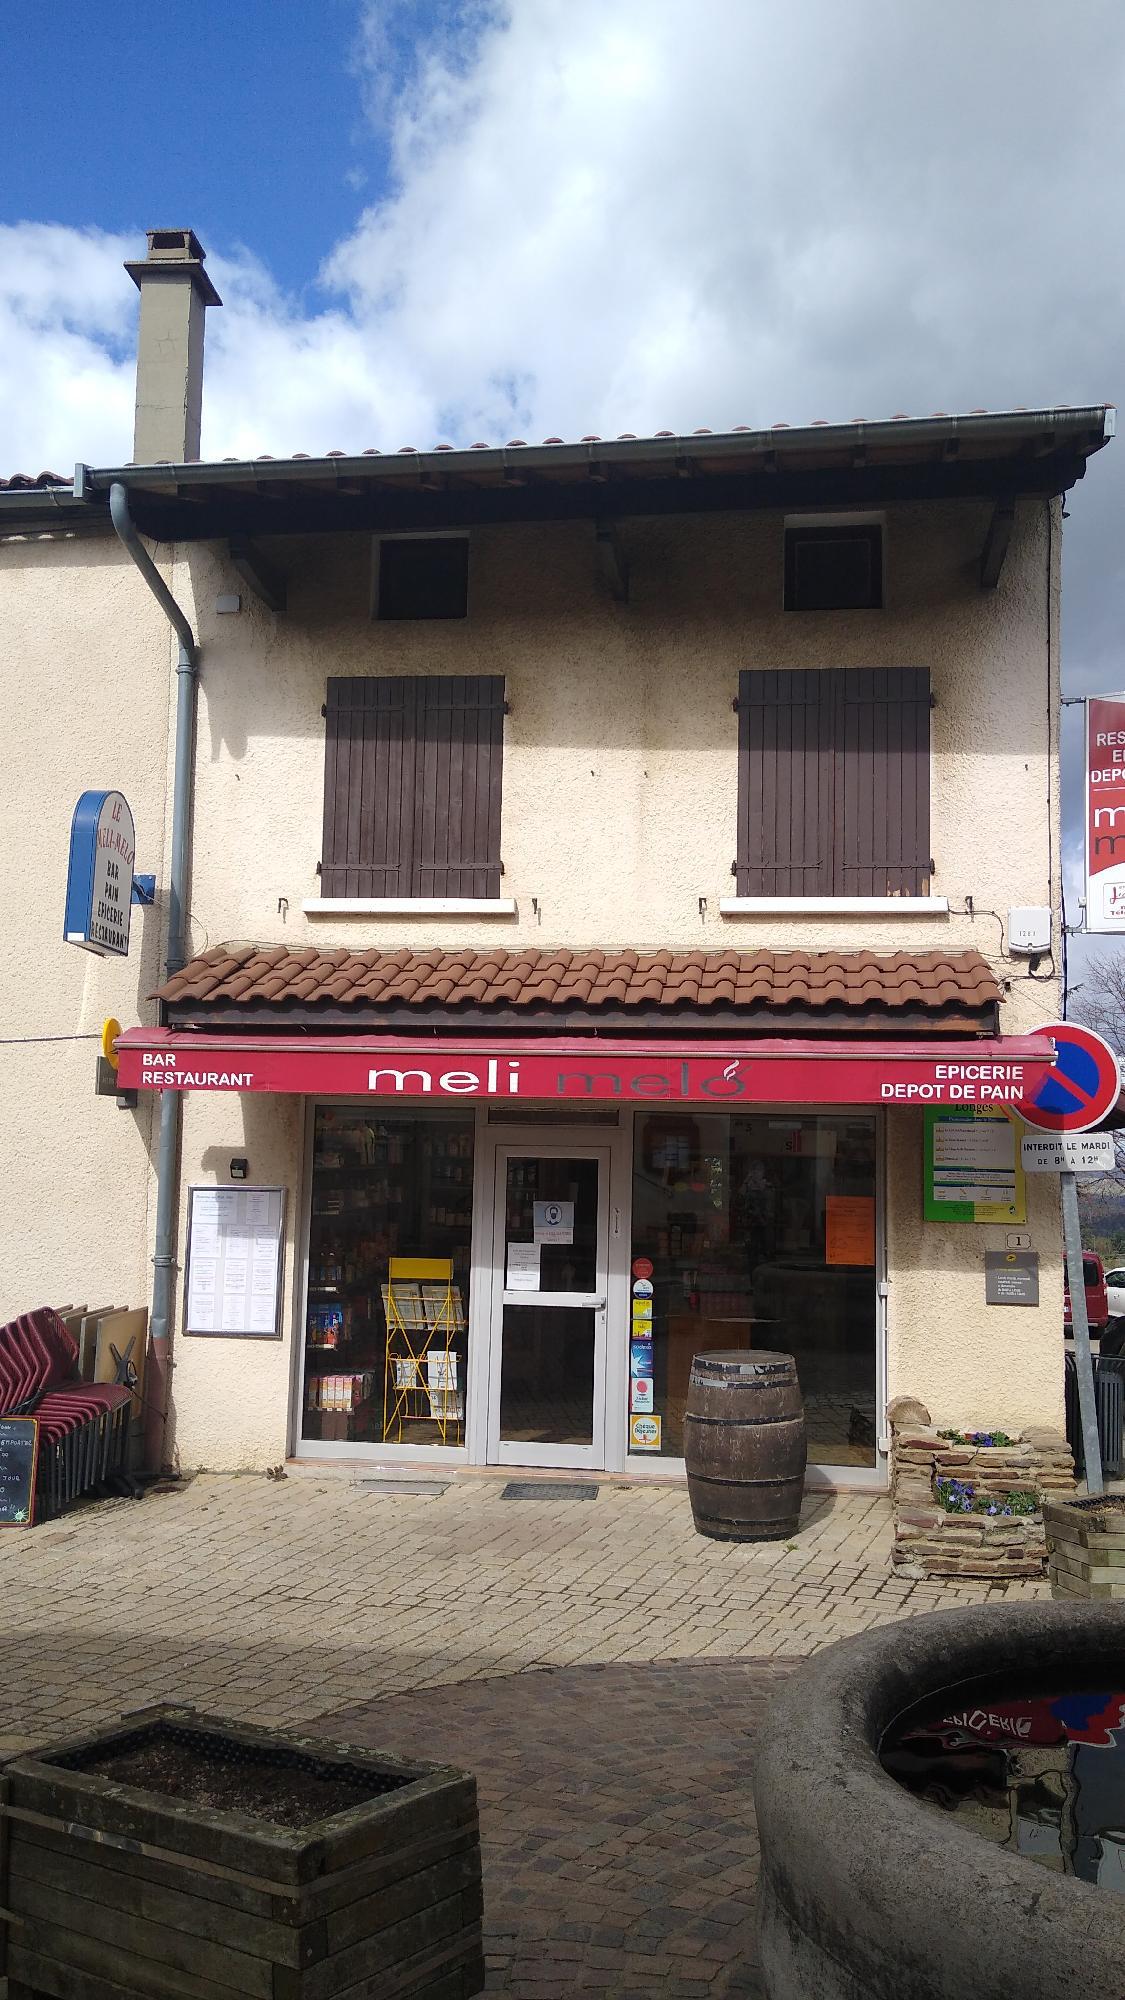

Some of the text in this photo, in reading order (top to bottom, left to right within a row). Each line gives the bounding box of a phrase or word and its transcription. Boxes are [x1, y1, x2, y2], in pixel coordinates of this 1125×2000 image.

[111, 800, 123, 822] LE
[106, 859, 119, 881] BAR
[104, 881, 119, 904] PAIN
[97, 900, 124, 928] EPICERIE
[90, 919, 129, 950] RESTAURANT
[142, 1053, 176, 1067] BAR
[142, 1071, 254, 1086] RESTAURANT
[368, 1059, 520, 1094] meli
[935, 1065, 1024, 1080] EPICERIE
[881, 1083, 1024, 1100] DEPOT DE PAIN
[1023, 1141, 1110, 1151] INTERDIT LE MARDI
[1015, 1237, 1021, 1246] 1
